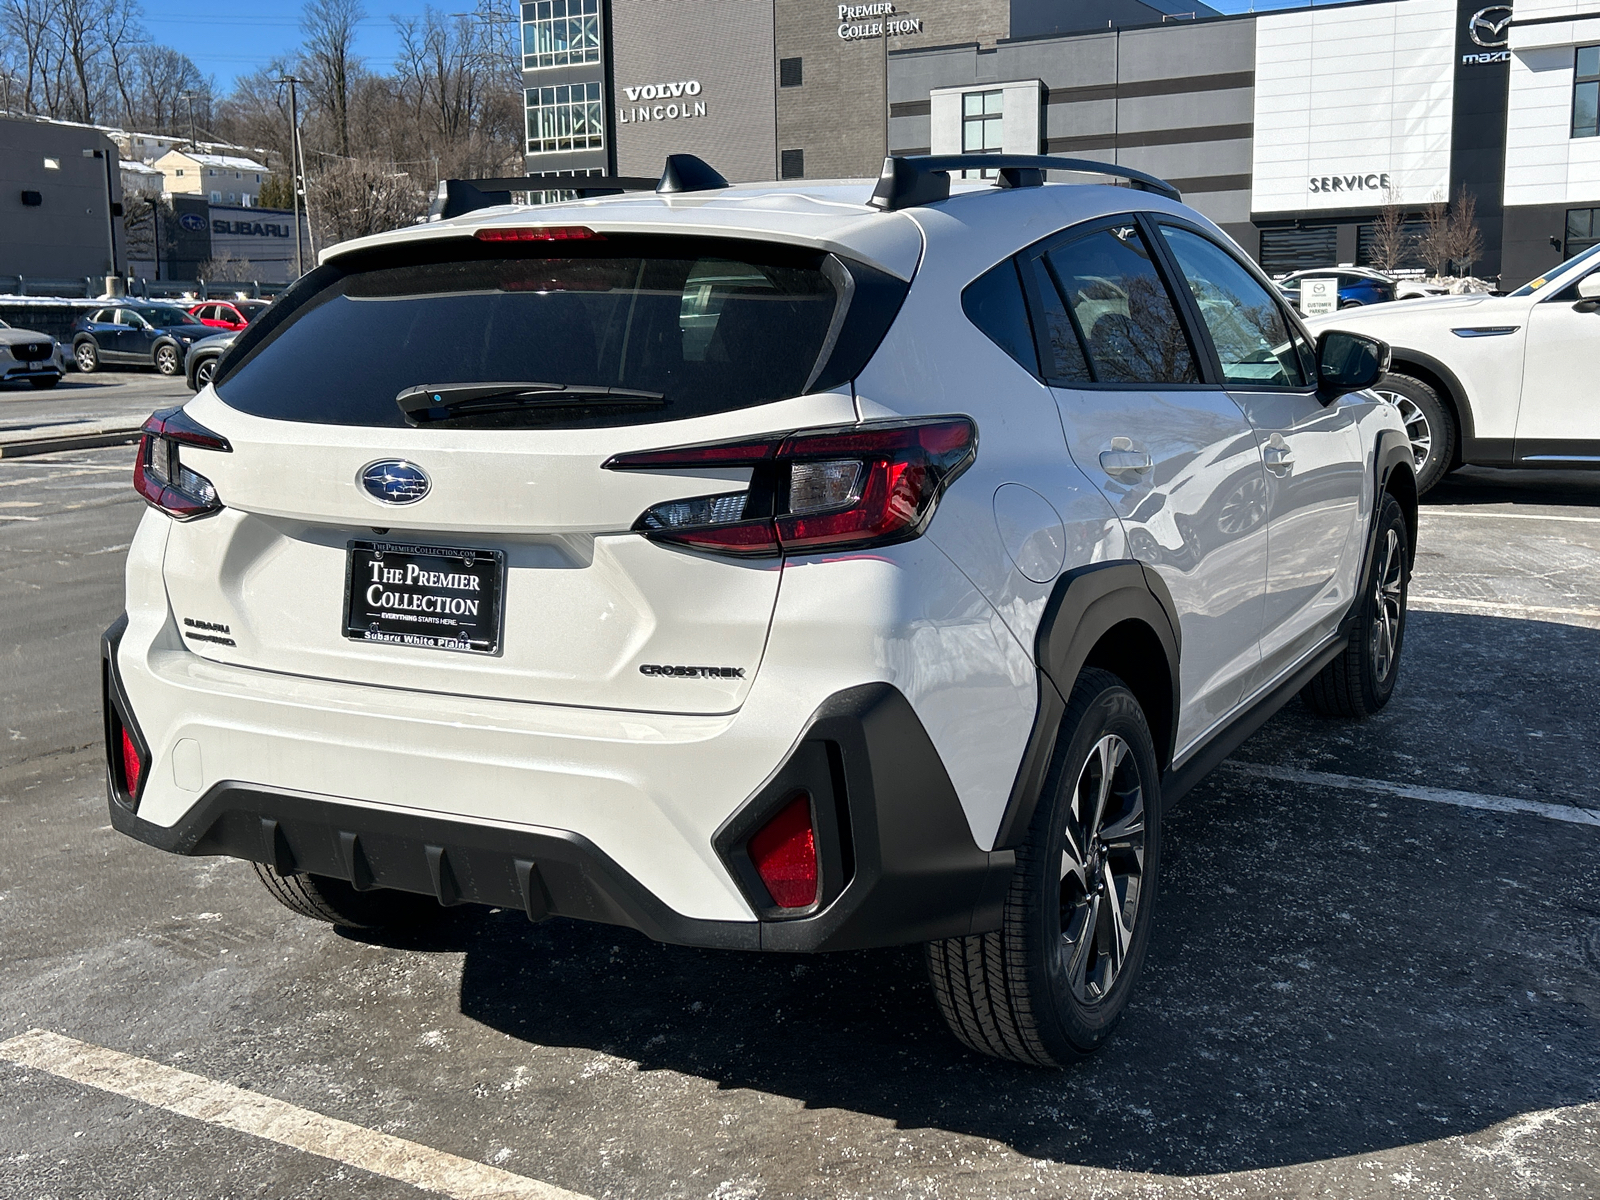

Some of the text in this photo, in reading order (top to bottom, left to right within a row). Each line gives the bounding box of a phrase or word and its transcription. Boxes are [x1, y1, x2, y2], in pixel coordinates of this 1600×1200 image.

[837, 2, 893, 20] PREMIER
[622, 80, 702, 102] VOLVO
[619, 101, 707, 123] LINCOLN
[1308, 173, 1390, 194] SERVICE
[212, 220, 290, 238] SUBARU
[368, 560, 481, 591] THE PREMIER
[366, 583, 480, 616] COLLECTION
[183, 617, 231, 635] SUBARU
[381, 612, 458, 626] EVERYTHING STARTS HERE.
[364, 630, 471, 651] Subaru White Plains
[639, 664, 747, 681] CROSSTREK
